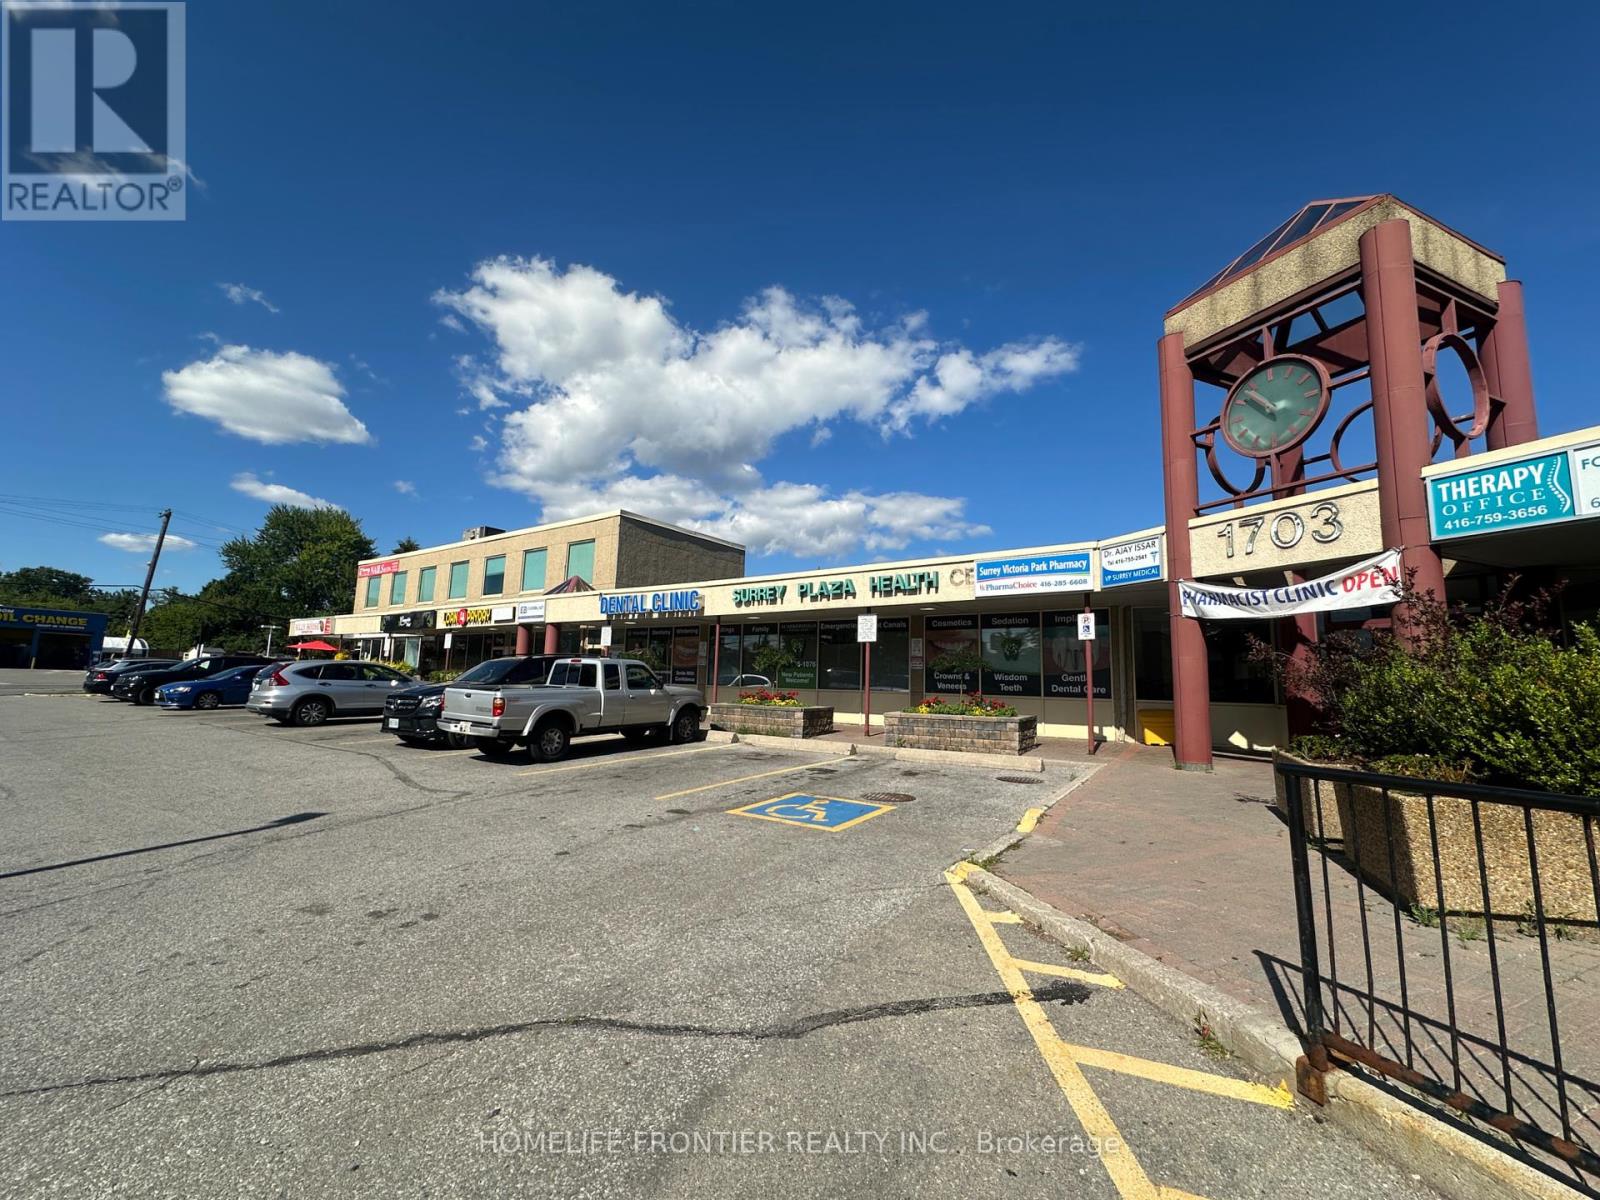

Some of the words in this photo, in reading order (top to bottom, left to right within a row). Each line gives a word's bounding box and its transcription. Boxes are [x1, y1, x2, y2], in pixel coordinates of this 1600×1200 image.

[1437, 463, 1545, 502] THERAPY
[1442, 487, 1546, 516] OFFICE
[1444, 505, 1548, 530] 416-759-3656
[1217, 502, 1343, 558] 1703
[1103, 550, 1114, 558] Dr.
[1115, 545, 1132, 555] AJAY
[1134, 540, 1156, 551] ISSAR
[979, 566, 1001, 577] Surrey
[1002, 563, 1029, 574] Victoria
[1031, 561, 1048, 572] Park
[1049, 559, 1087, 570] Pharmacy
[1112, 571, 1131, 581] SURREY
[1132, 567, 1158, 577] MEDICAL
[732, 583, 787, 603] SURREY
[797, 578, 856, 600] PLAZA
[869, 570, 939, 595] HEALTH
[985, 581, 1037, 592] PharmaChoice
[1182, 589, 1269, 607] PHARMACIST
[1274, 579, 1338, 604] CLINIC
[1341, 566, 1399, 594] OPEN
[599, 592, 648, 615] DENTAL
[652, 589, 700, 613] CLINIC
[0, 612, 18, 622] IL
[22, 614, 89, 626] CHANGE
[931, 619, 972, 628] Cosmetics
[991, 617, 1029, 626] Sedation
[1054, 615, 1078, 624] Impl
[934, 671, 961, 680] Crowns
[994, 672, 1028, 681] Wisdom
[1061, 674, 1086, 682] Gentl
[999, 683, 1023, 692] Teeth
[1051, 685, 1081, 693] Dental
[1083, 685, 1107, 694] Cre
